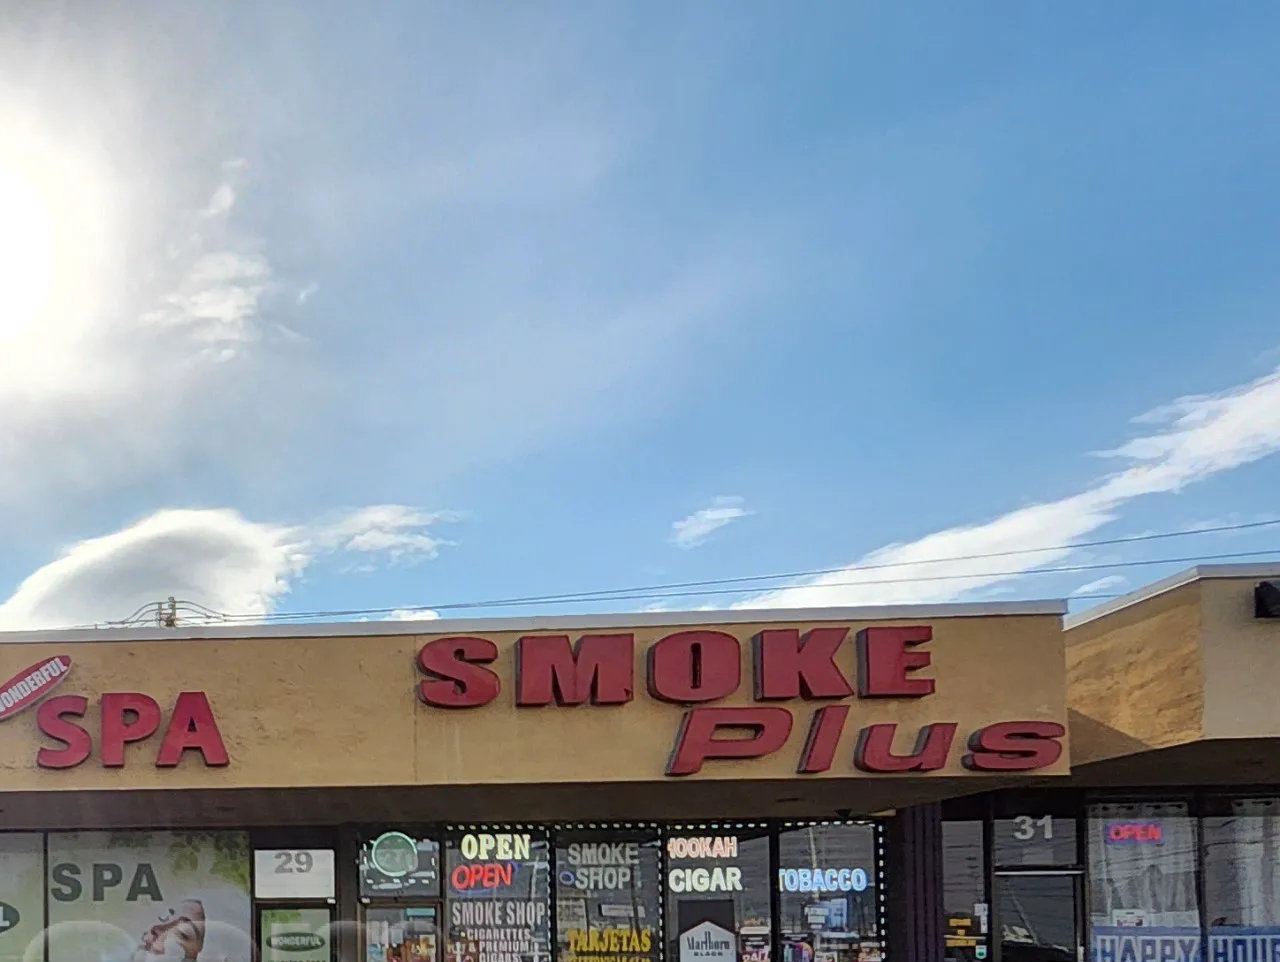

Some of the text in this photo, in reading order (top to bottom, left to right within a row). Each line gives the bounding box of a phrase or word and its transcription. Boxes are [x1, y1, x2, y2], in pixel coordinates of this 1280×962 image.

[418, 624, 936, 707] SMOKE
[36, 691, 230, 769] SPA
[664, 705, 1065, 776] Plus
[1013, 815, 1053, 840] 31
[1109, 823, 1161, 842] OPEN
[461, 833, 531, 861] OPEN
[567, 843, 640, 865] SMOKE
[274, 852, 314, 874] 29
[51, 863, 164, 903] SPA
[451, 863, 513, 891] OPEN
[575, 867, 631, 890] SHOP
[669, 867, 743, 892] CIGAR
[779, 868, 868, 892] TOBACCO
[452, 901, 502, 926] SMOKE
[507, 901, 545, 926] SHOP
[467, 928, 531, 940] CIGARETTES
[568, 928, 651, 952] TARJETAS
[687, 931, 730, 950] Marlboro
[479, 941, 528, 952] PREMIUM
